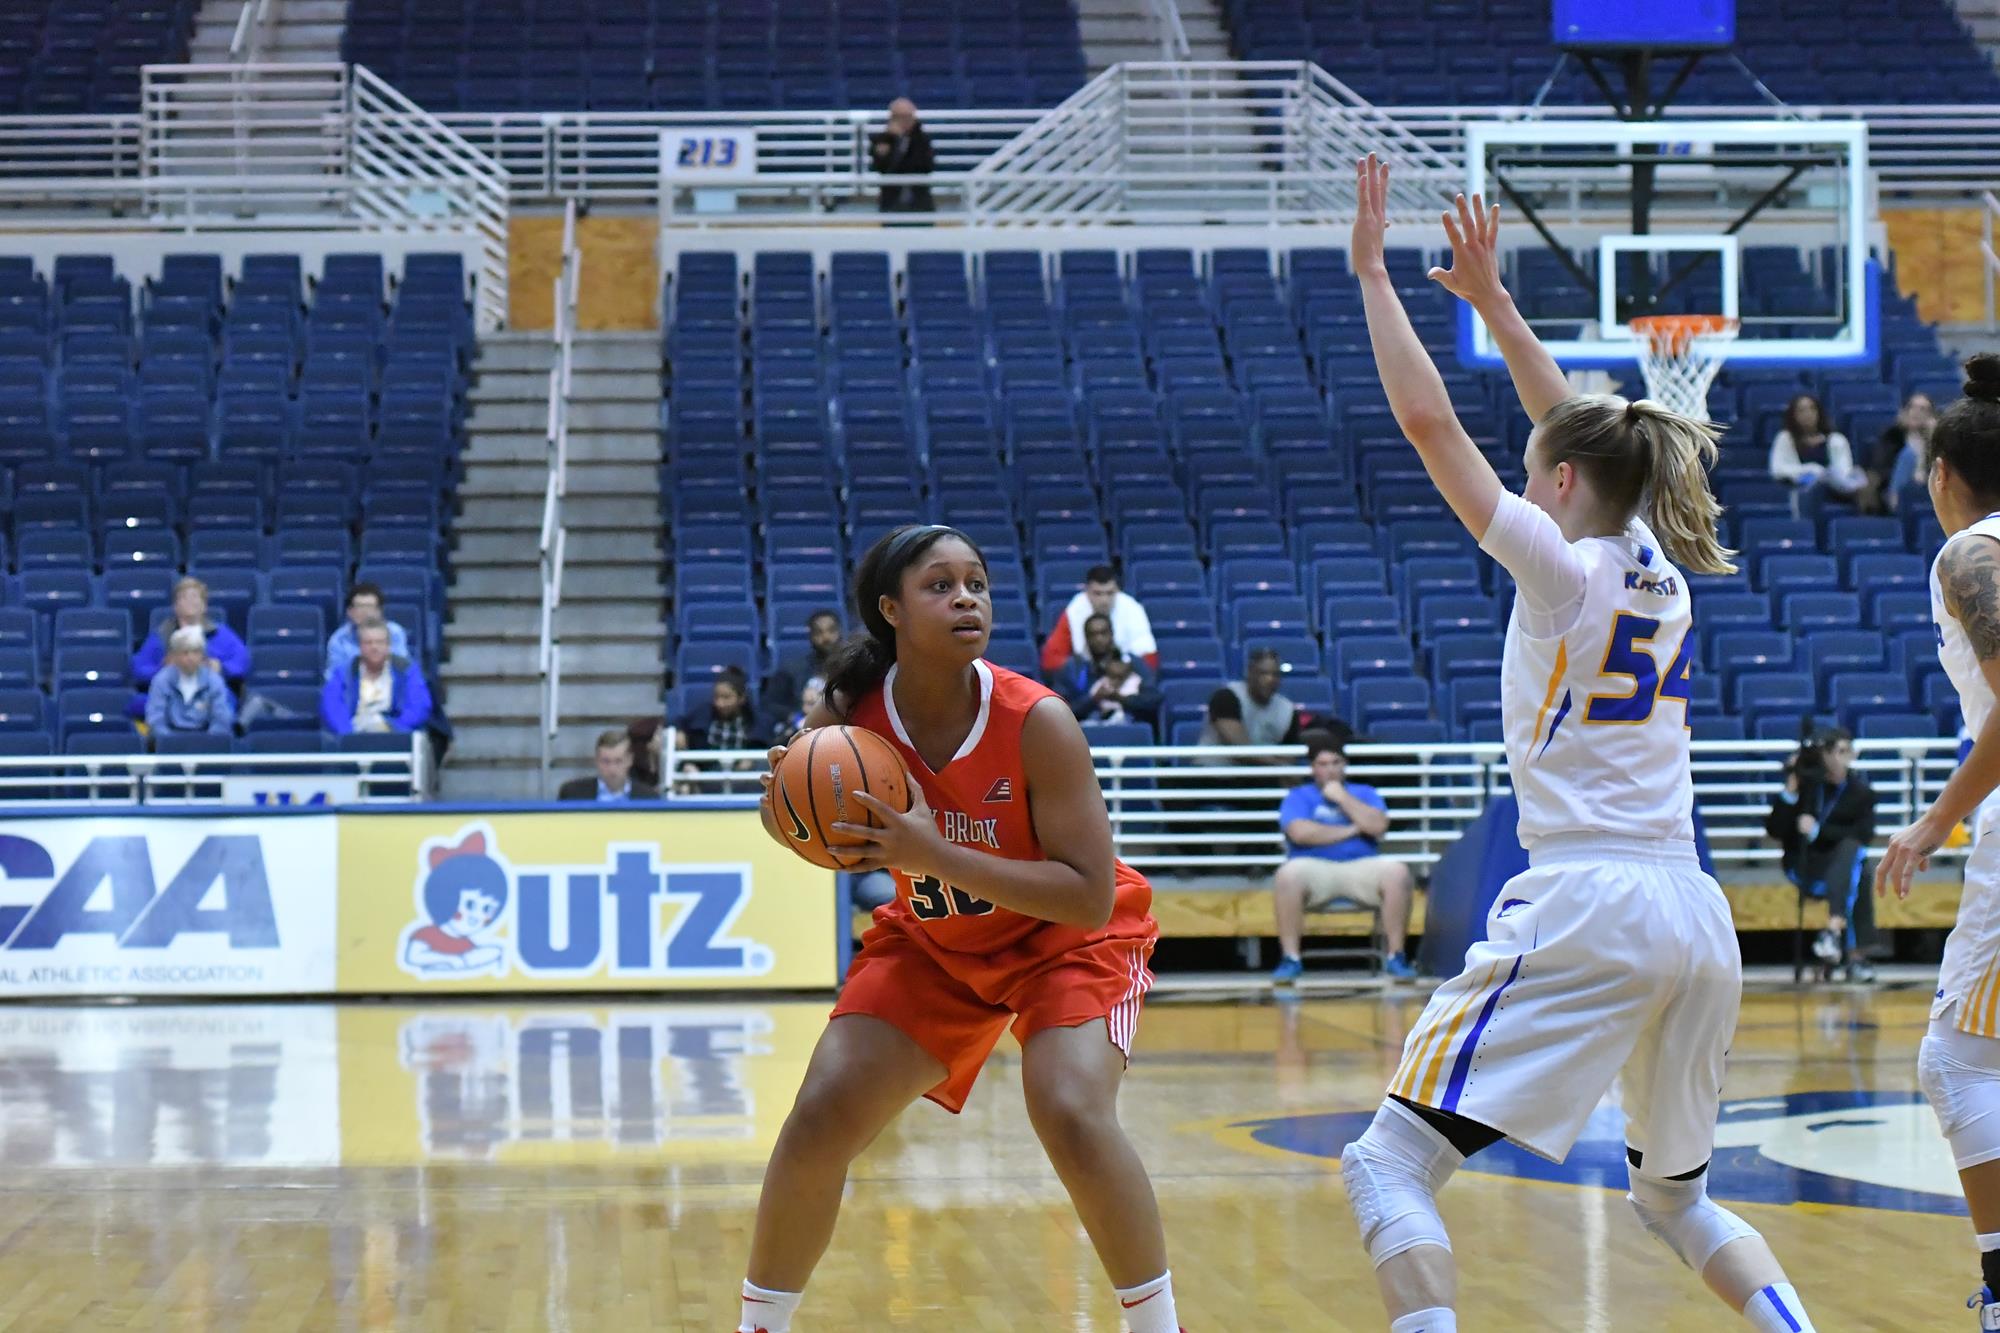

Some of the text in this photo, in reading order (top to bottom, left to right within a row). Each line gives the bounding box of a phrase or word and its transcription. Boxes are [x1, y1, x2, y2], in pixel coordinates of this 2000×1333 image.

[678, 138, 738, 168] 213
[1581, 609, 1694, 731] 54
[127, 966, 264, 983] ASSOCIATION
